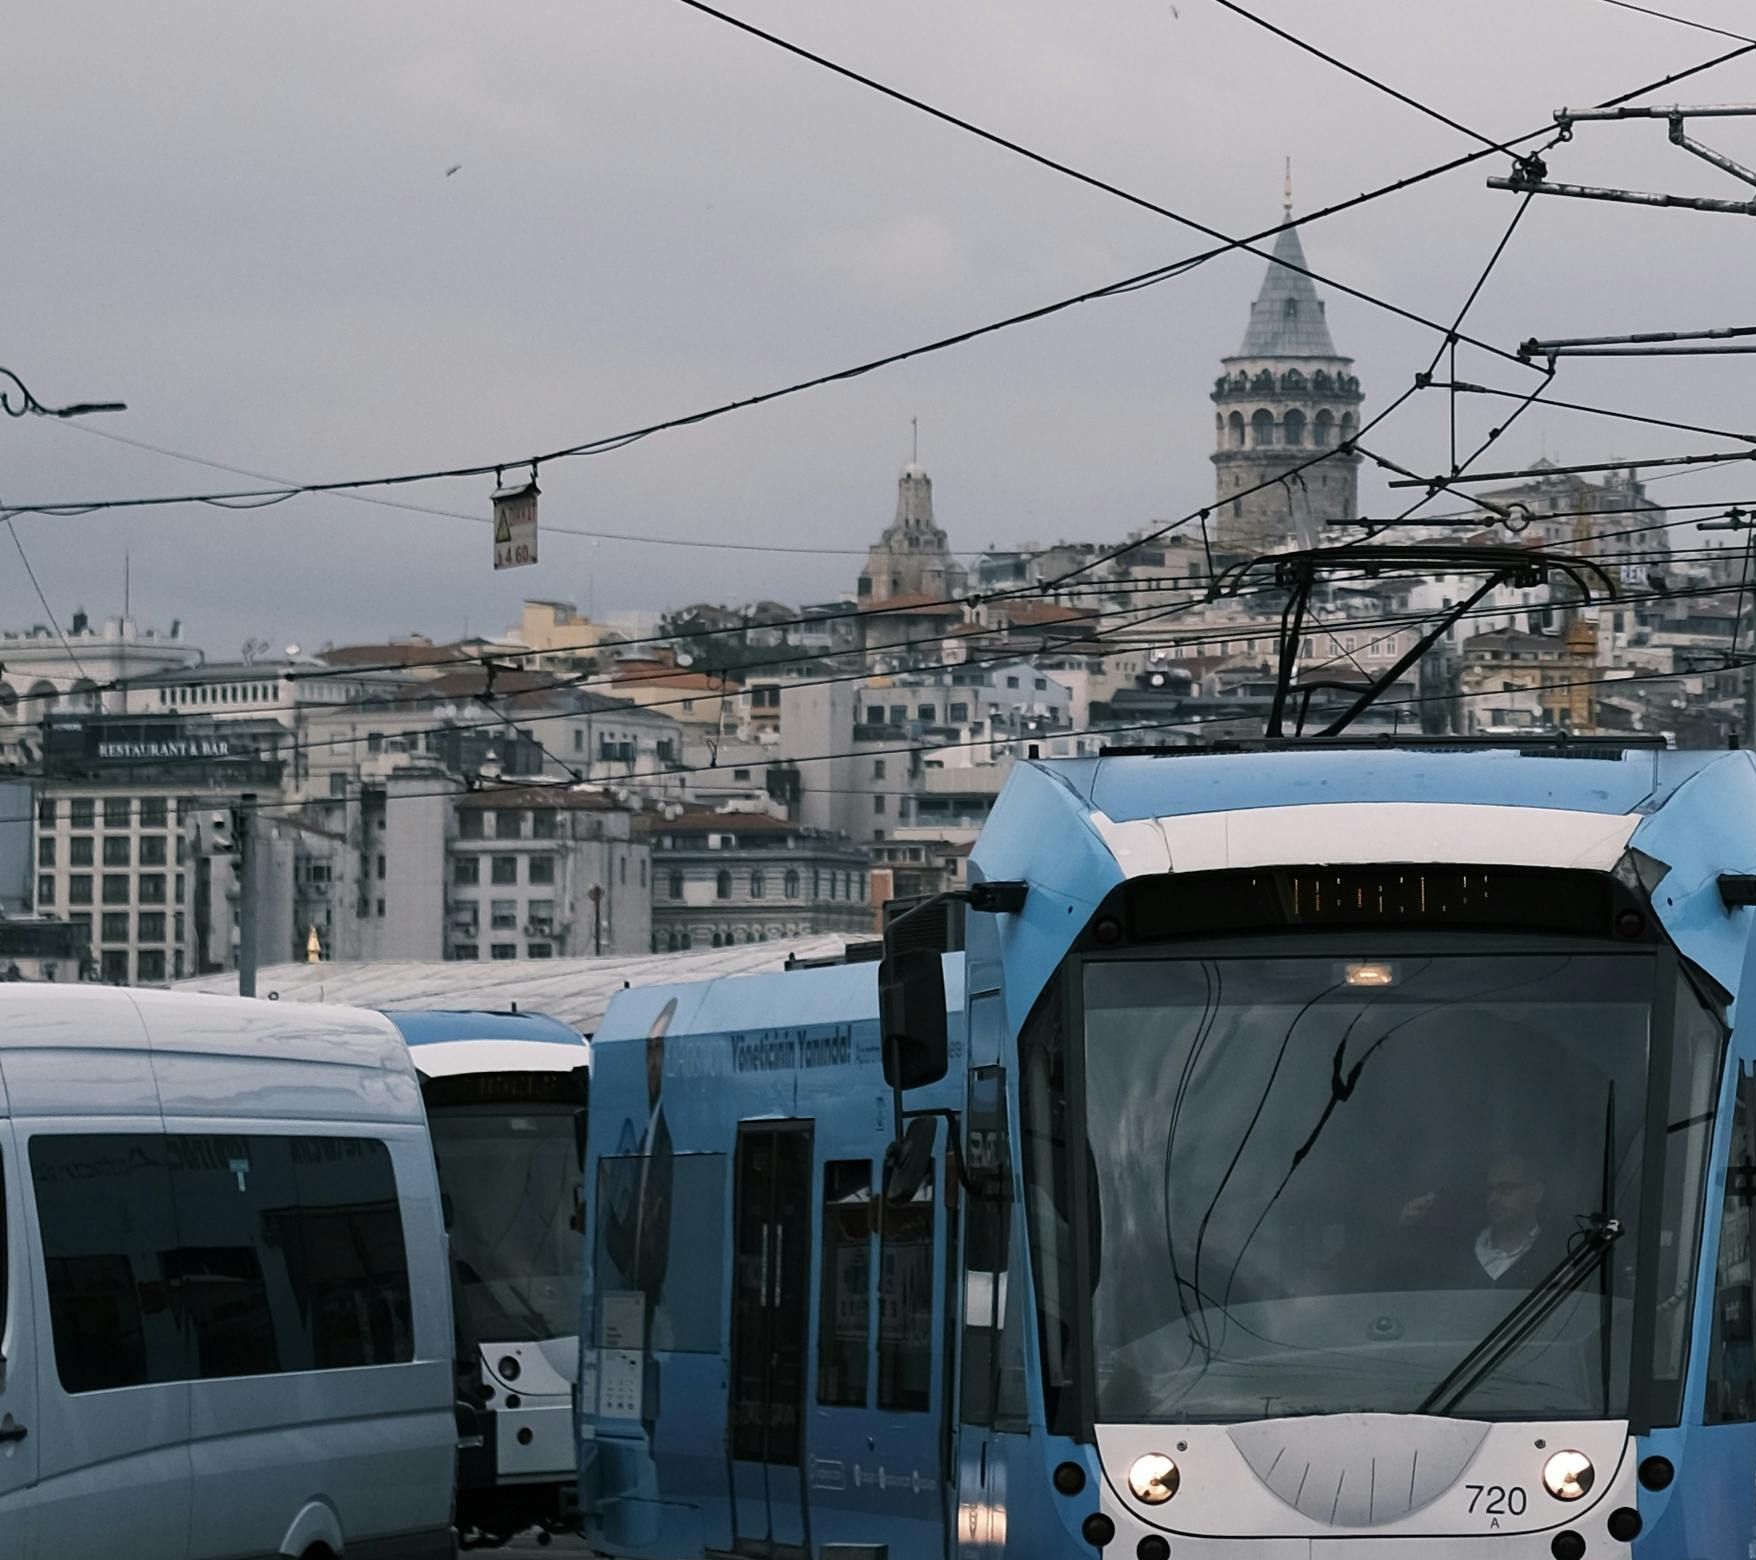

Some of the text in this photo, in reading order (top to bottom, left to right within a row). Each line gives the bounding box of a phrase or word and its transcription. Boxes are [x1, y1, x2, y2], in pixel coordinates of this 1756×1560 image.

[100, 742, 187, 757] RESTAURANT
[202, 741, 229, 755] BAR
[1465, 1485, 1527, 1516] 720
[1490, 1517, 1500, 1529] A
